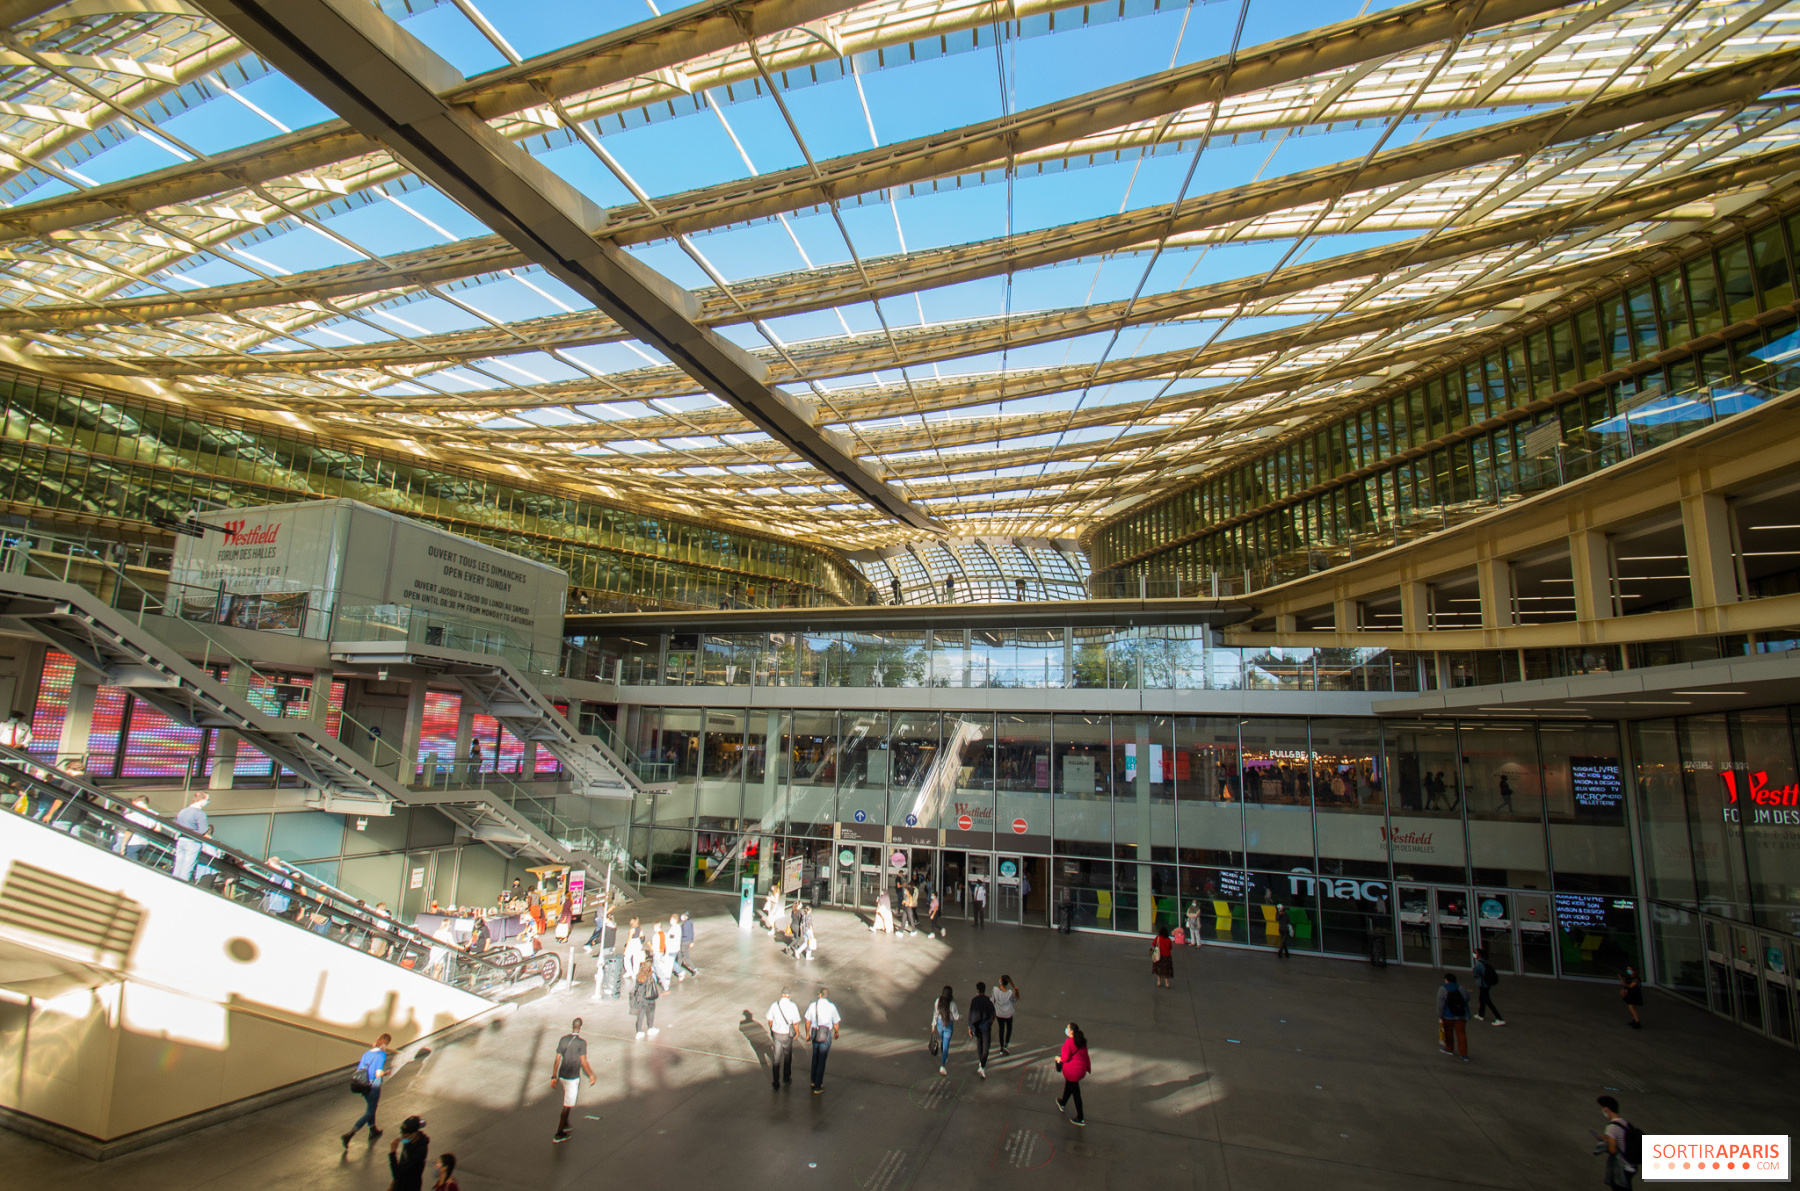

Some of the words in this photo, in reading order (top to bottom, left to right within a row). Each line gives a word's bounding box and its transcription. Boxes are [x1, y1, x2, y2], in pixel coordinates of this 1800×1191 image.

[222, 519, 282, 546] Westfield
[217, 550, 239, 561] FORUM
[239, 549, 252, 560] DES
[252, 547, 277, 559] HALLES
[428, 545, 458, 563] OUVERT
[458, 555, 477, 570] TOUS
[477, 561, 490, 573] LES
[490, 565, 527, 584] DIMANCHES
[443, 565, 463, 580] OPEN
[464, 571, 486, 586] EVERY
[486, 577, 512, 593] SUNDAY
[403, 589, 421, 601] OPEN
[421, 594, 439, 606] UNTIL
[456, 602, 466, 612] PM
[465, 605, 481, 615] FROM
[481, 608, 503, 619] MONDAY
[502, 613, 511, 622] TO
[510, 614, 535, 627] SATURDAY
[414, 579, 437, 593] OUVERT
[481, 596, 488, 606] DU
[488, 599, 504, 610] LUNDI
[504, 603, 513, 612] AU
[512, 604, 530, 616] SAMEDI
[1593, 766, 1619, 774] LIVRE
[1723, 808, 1770, 824] FOUM
[1773, 810, 1800, 825] DES
[1379, 826, 1434, 845] Westfield
[1400, 844, 1412, 852] DES
[1412, 845, 1435, 854] HALLES
[1288, 867, 1387, 901] fnac
